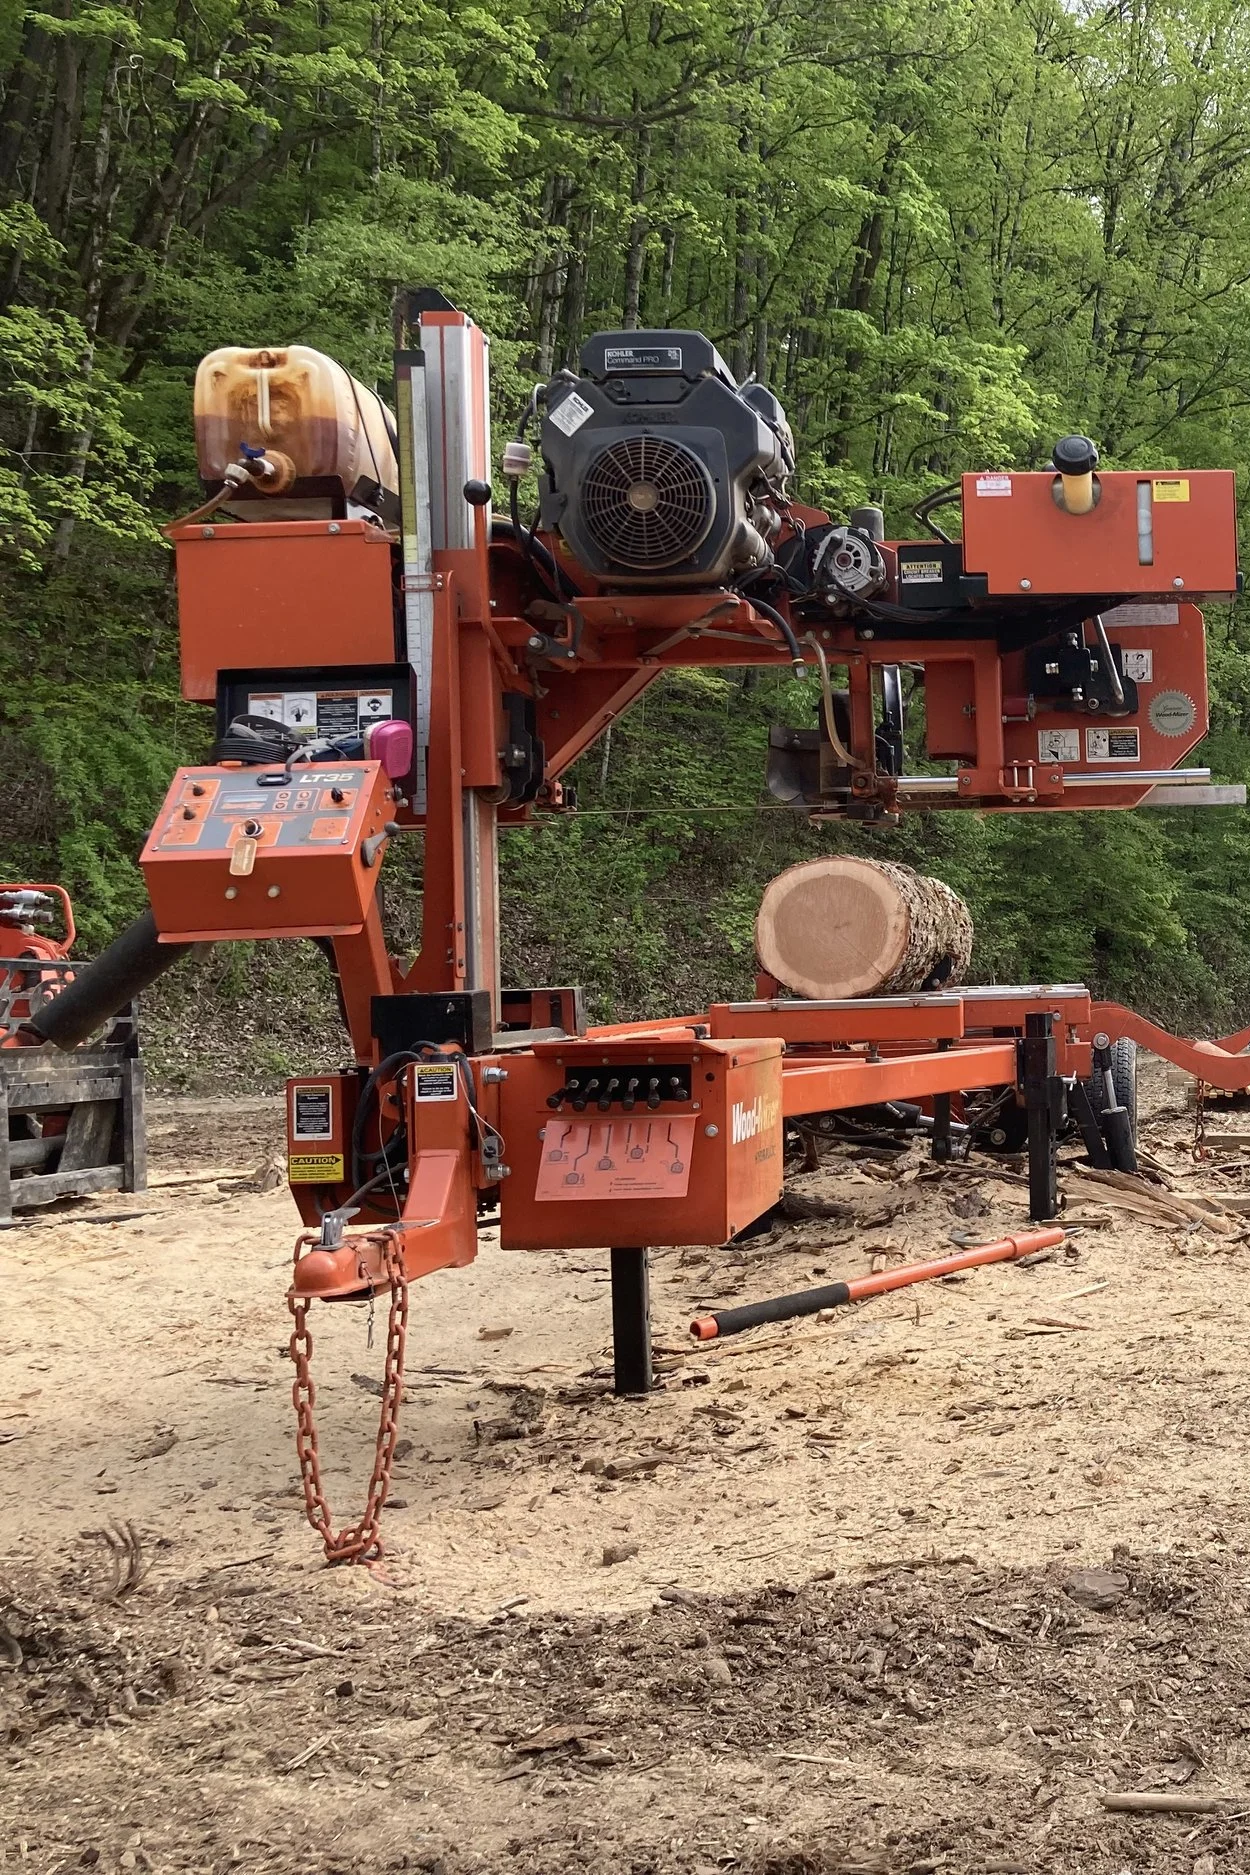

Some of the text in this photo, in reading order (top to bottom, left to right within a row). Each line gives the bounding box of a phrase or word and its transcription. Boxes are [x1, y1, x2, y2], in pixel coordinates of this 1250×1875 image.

[607, 350, 634, 358] KOHLER
[643, 355, 660, 363] PRO
[299, 772, 355, 783] LT35
[291, 1157, 336, 1165] CAUTION
